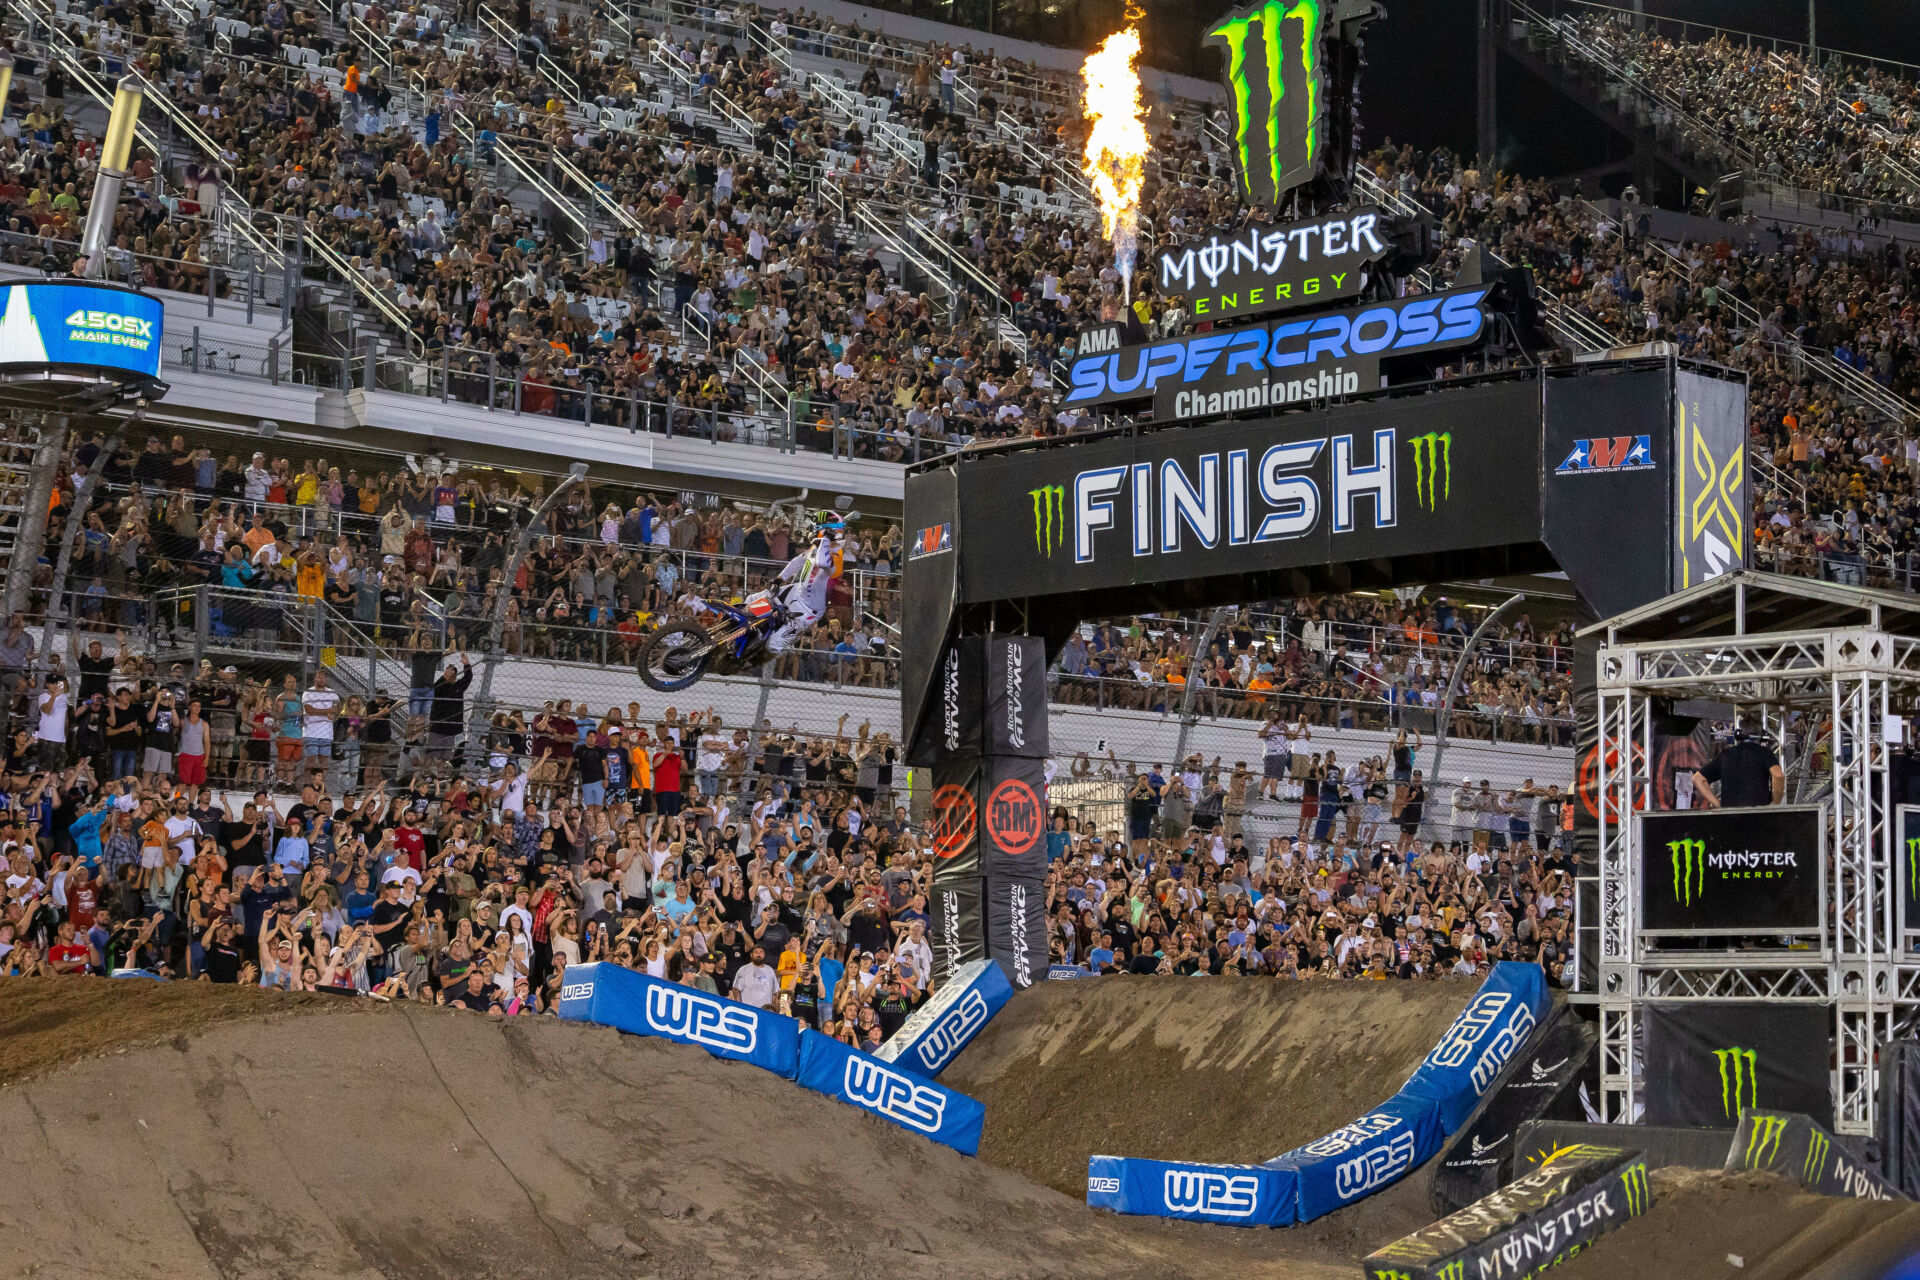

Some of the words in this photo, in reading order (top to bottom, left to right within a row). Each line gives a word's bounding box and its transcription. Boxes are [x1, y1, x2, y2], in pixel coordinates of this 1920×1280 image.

[1160, 213, 1385, 291] MONSTER
[1195, 272, 1348, 315] ENERGY
[65, 309, 153, 340] 450SX
[69, 330, 110, 344] MAIN
[112, 335, 150, 351] EVENT
[1065, 287, 1489, 402] SUPERCROSS
[1078, 327, 1120, 355] AMA
[1175, 367, 1360, 418] Championship
[1554, 434, 1657, 471] AMA
[705, 495, 719, 508] 144
[1074, 427, 1397, 564] FINISH
[908, 523, 952, 557] AMA
[996, 800, 1035, 833] RM
[1708, 849, 1798, 868] MONSTER
[1721, 871, 1785, 880] ENERGY
[943, 891, 952, 946] MOUNTAIN
[1010, 884, 1018, 938] MOUNTAIN
[1012, 938, 1021, 970] ROCKY
[1049, 970, 1077, 980] WPS
[561, 982, 594, 1001] WPS
[645, 984, 759, 1054] WPS
[917, 988, 988, 1070] WPS
[1432, 992, 1512, 1067] WPS
[1470, 1002, 1536, 1097] WPS
[844, 1054, 947, 1133] WPS
[1088, 1177, 1120, 1194] WPS
[1335, 1130, 1415, 1199] WPS
[1164, 1170, 1259, 1217] WPS
[1478, 1190, 1615, 1280] MONSTER
